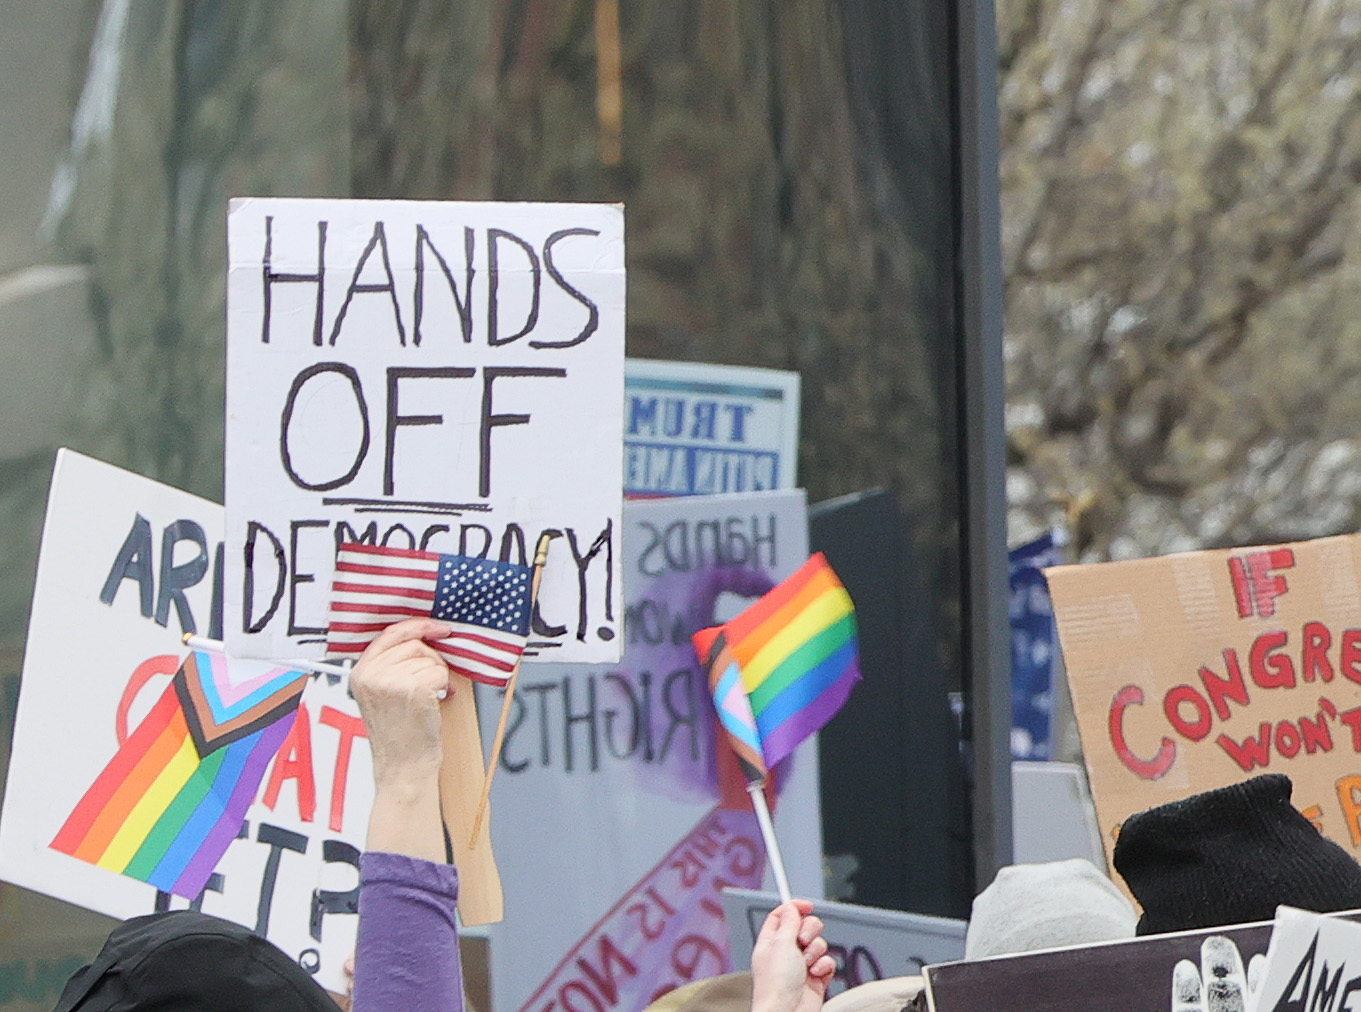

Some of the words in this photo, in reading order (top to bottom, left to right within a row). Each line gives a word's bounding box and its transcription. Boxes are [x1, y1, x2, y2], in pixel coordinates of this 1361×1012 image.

[262, 215, 601, 349] HANDS
[279, 361, 568, 499] OFF
[1228, 549, 1294, 618] IF
